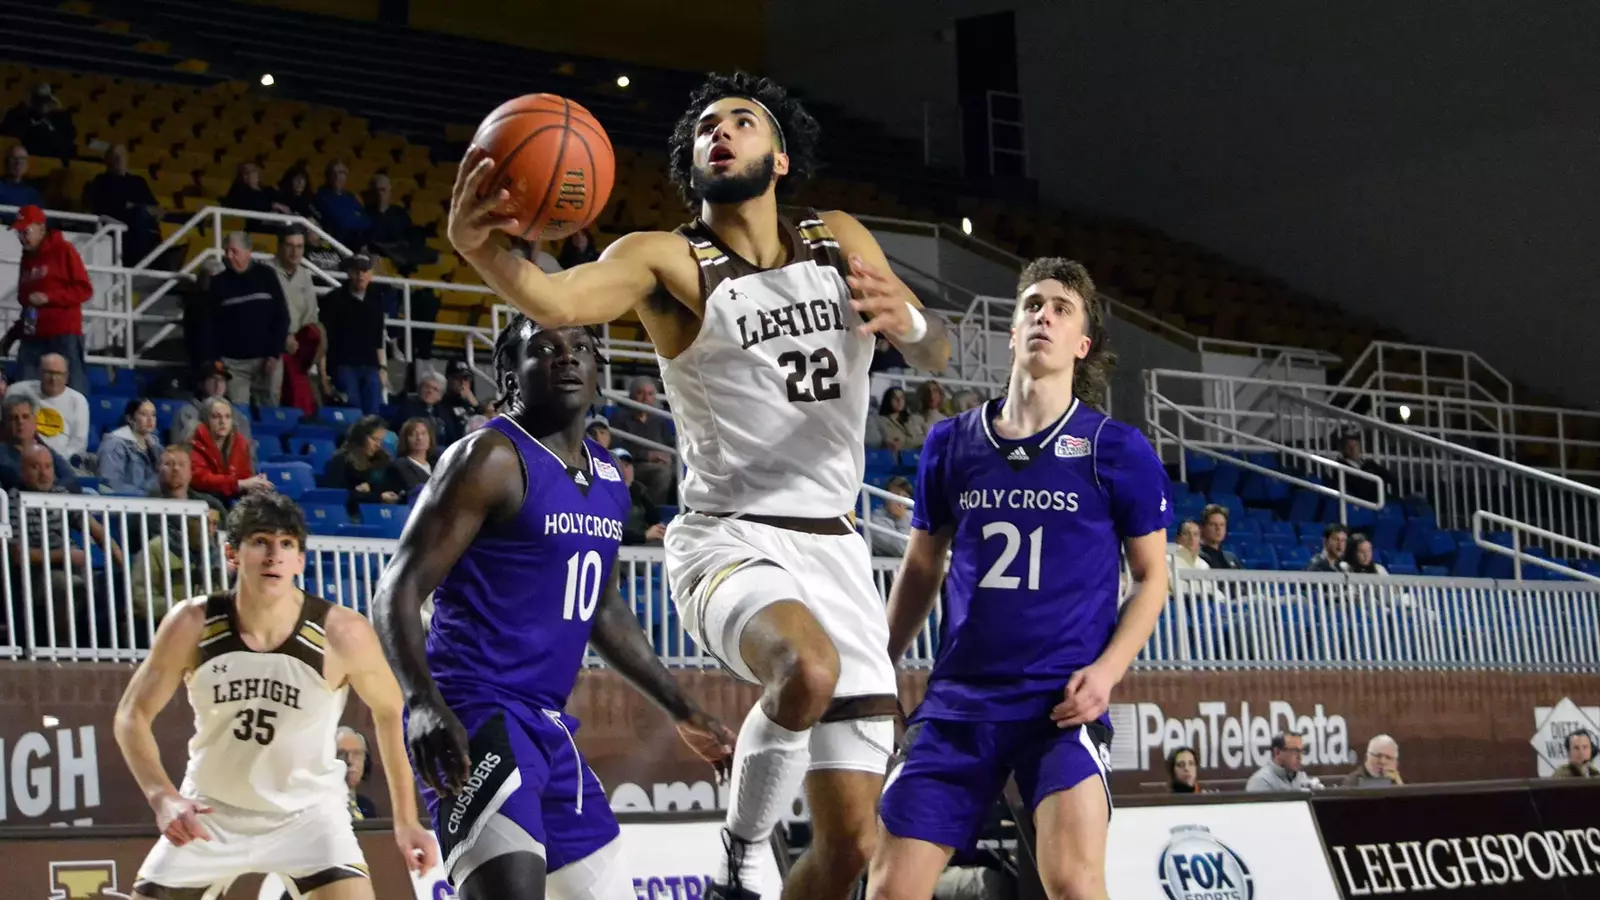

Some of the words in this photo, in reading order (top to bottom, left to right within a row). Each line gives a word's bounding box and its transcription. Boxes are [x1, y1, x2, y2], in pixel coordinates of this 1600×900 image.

[555, 169, 585, 210] THE
[777, 347, 841, 402] 22
[959, 489, 1005, 510] HOLY
[1008, 489, 1079, 512] CROSS
[978, 521, 1043, 590] 21
[563, 550, 602, 622] 10
[213, 677, 301, 709] LEHIGH
[233, 708, 277, 746] 35
[448, 752, 501, 834] CRUSADERS
[1172, 852, 1235, 891] FOX
